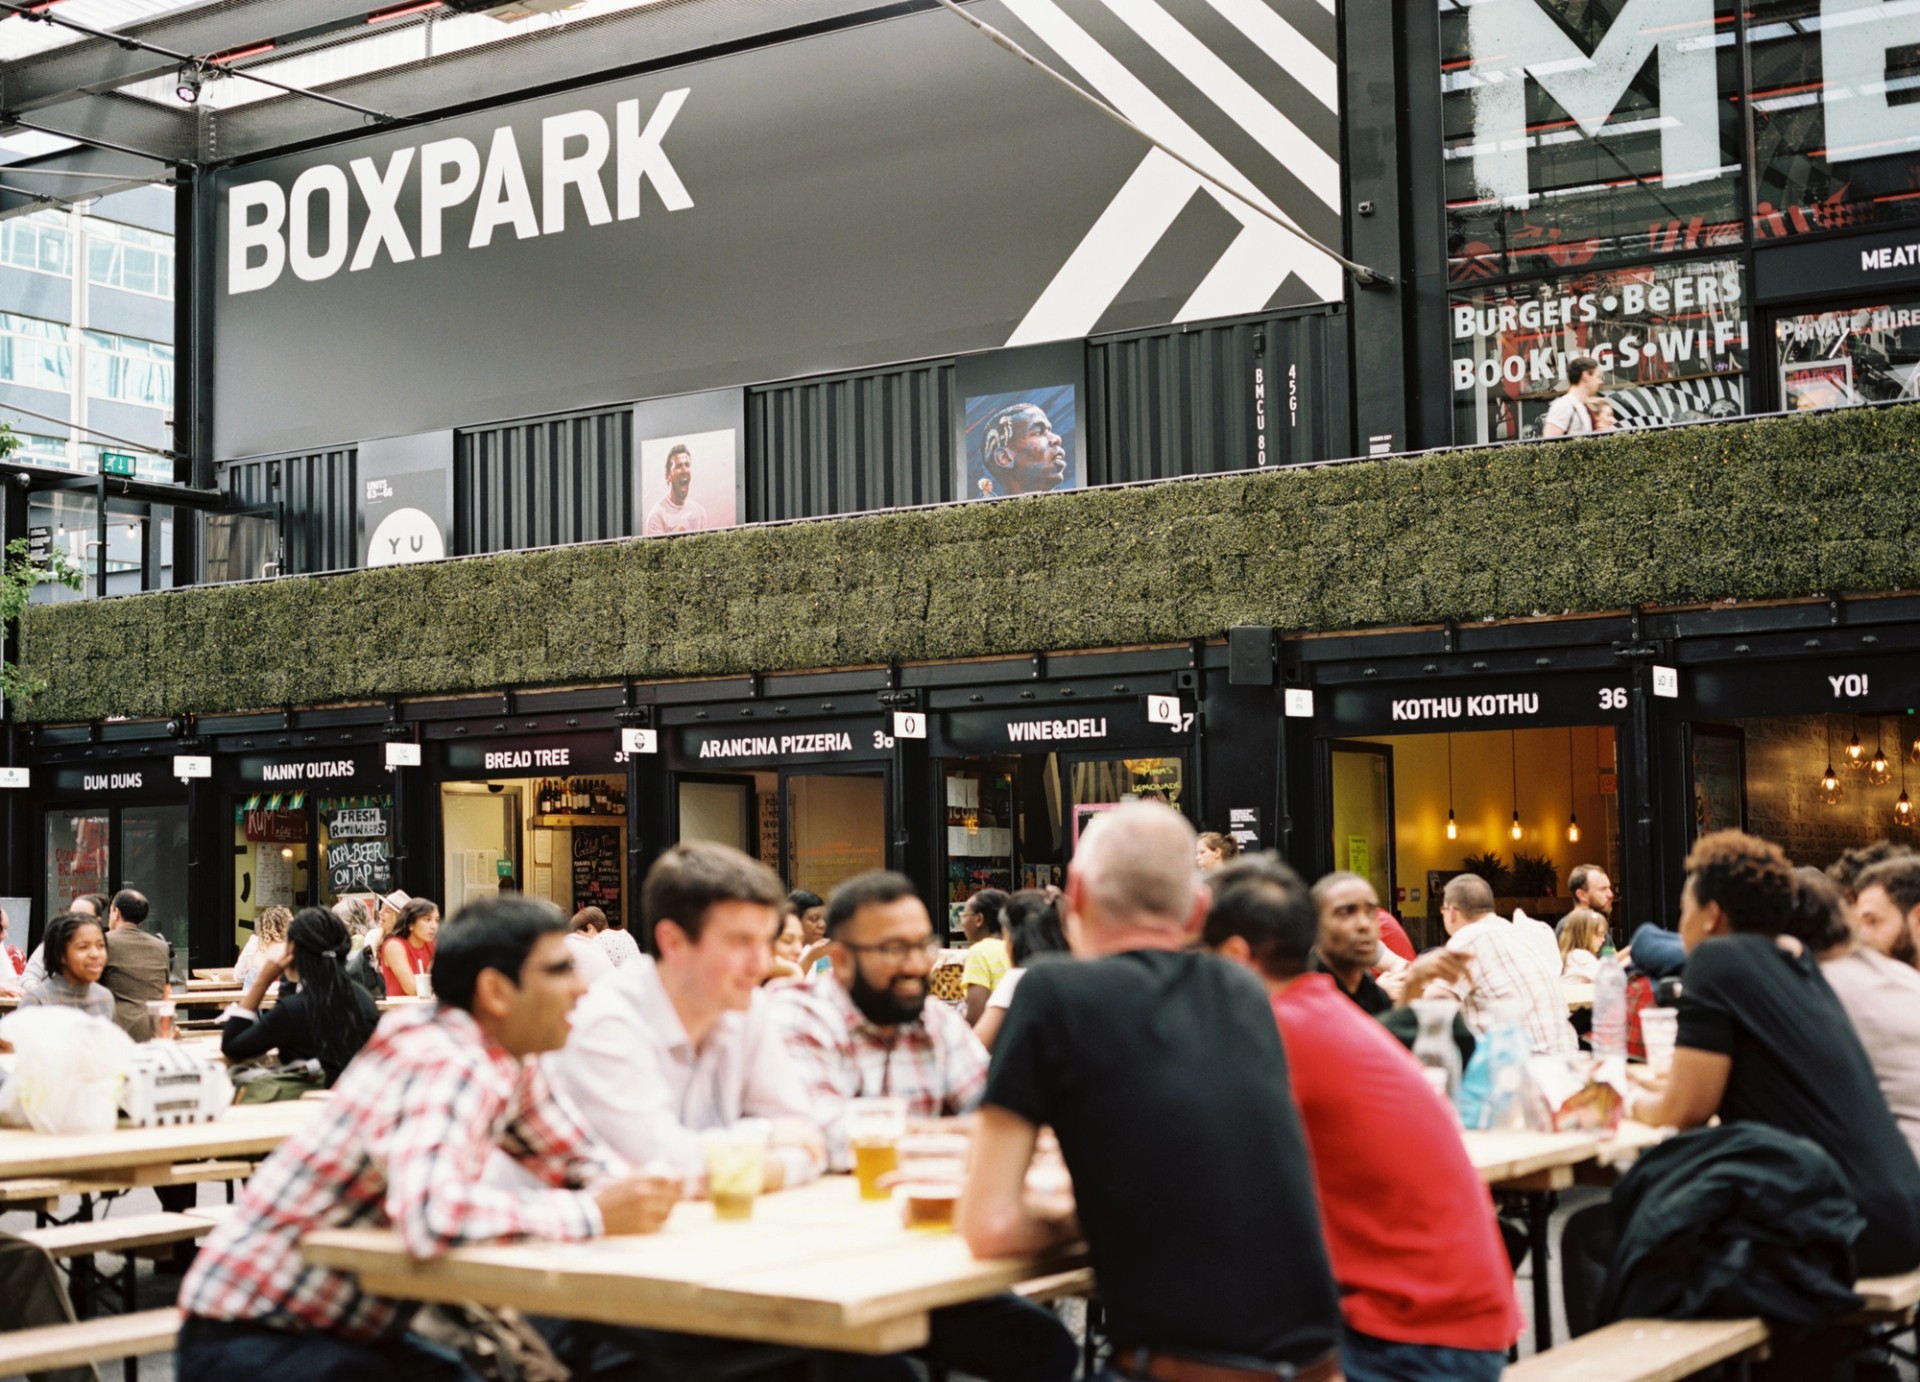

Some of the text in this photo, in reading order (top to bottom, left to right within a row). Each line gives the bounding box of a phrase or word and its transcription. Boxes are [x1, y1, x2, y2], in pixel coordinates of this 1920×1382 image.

[229, 87, 694, 295] BOXPARK
[1861, 244, 1920, 271] MEAT
[1255, 368, 1265, 430] BMCU
[1288, 364, 1297, 427] 45G1
[366, 480, 388, 491] UNITS
[1828, 673, 1868, 698] YO!
[1392, 693, 1539, 720] KOTHU KOTHU
[1598, 687, 1628, 709] 36
[1007, 717, 1107, 742] WINE&DELI
[699, 732, 852, 758] ARANCINA PIZZERIA
[263, 760, 354, 781] NANNY OUTARS
[485, 748, 569, 769] BREAD TREE
[83, 772, 142, 790] DUM DUMS
[341, 811, 376, 823] FRESH
[351, 841, 387, 863] BEER
[335, 863, 372, 886] ON TAP
